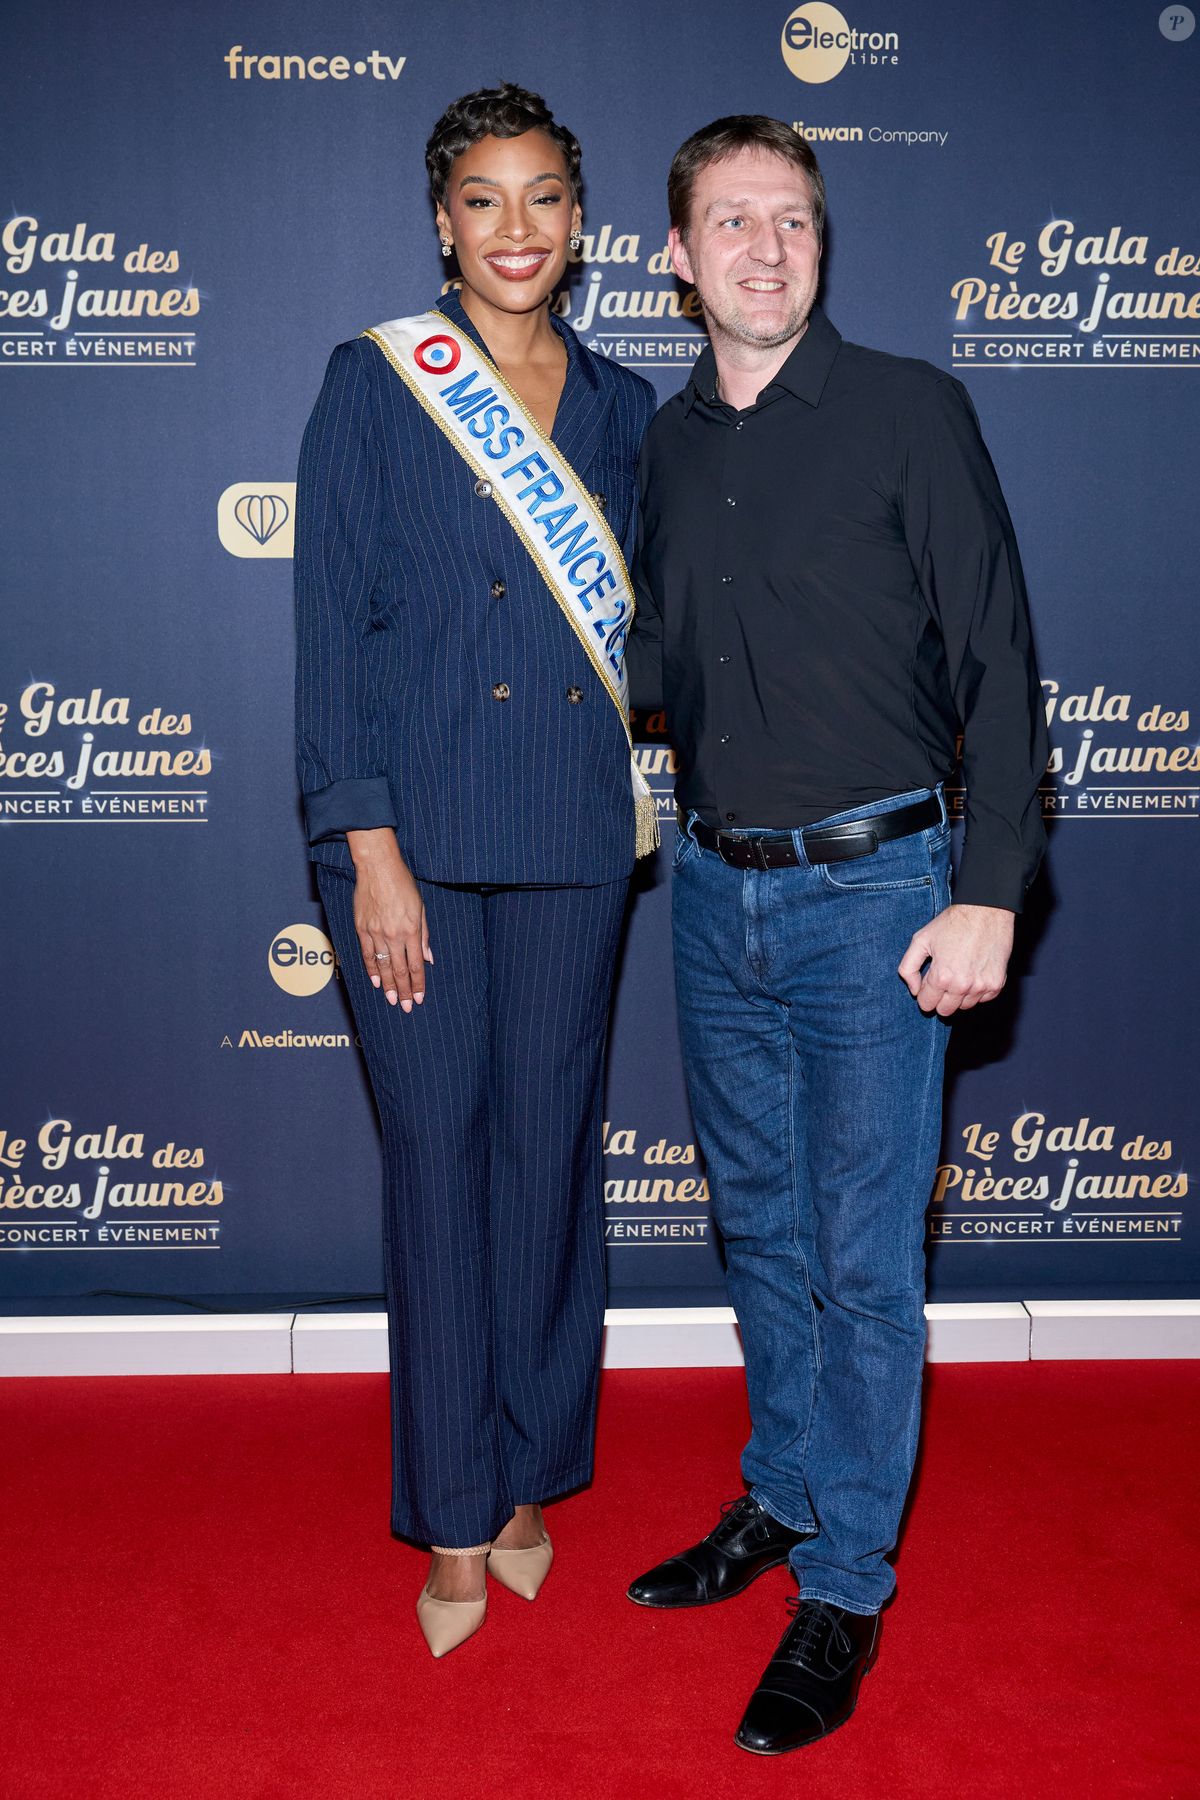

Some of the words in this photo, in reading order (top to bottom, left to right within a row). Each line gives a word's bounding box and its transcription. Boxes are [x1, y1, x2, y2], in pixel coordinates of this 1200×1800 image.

[784, 16, 899, 51] electron
[850, 53, 899, 65] libre
[868, 126, 948, 146] Company
[2, 216, 115, 274] Gala
[123, 244, 180, 273] des
[986, 231, 1026, 275] Le
[1038, 219, 1149, 277] Gala
[49, 269, 200, 331] jaunes
[950, 277, 1079, 321] Pièces
[65, 338, 196, 356] ÉVÉNEMENT
[588, 339, 709, 357] ÉVÉNEMEN
[952, 343, 976, 357] LE
[984, 343, 1084, 358] CONCERT
[439, 370, 525, 460] MISS
[501, 451, 617, 614] FRANCE
[19, 682, 130, 737] Gala
[137, 707, 192, 736] des
[1137, 704, 1190, 732] des
[66, 732, 212, 790] jaunes
[82, 797, 208, 814] ÉVÉNEMENT
[1077, 793, 1200, 809] ÉVÉNEMENT
[220, 1035, 233, 1048] A
[238, 1030, 349, 1048] Mediawan
[38, 1119, 144, 1170] Gala
[152, 1143, 204, 1168] des
[643, 1139, 695, 1165] des
[962, 1123, 1000, 1161] Le
[1011, 1112, 1115, 1162] Gala
[1120, 1135, 1172, 1161] des
[83, 1166, 224, 1219] jaunes
[934, 1164, 1049, 1202] Pièces
[1050, 1158, 1188, 1211] jaunes
[98, 1226, 220, 1242] ÉVÉNEMENT
[931, 1222, 953, 1234] LE
[960, 1221, 1055, 1235] CONCERT
[1062, 1218, 1182, 1233] ÉVÉNEMENT
